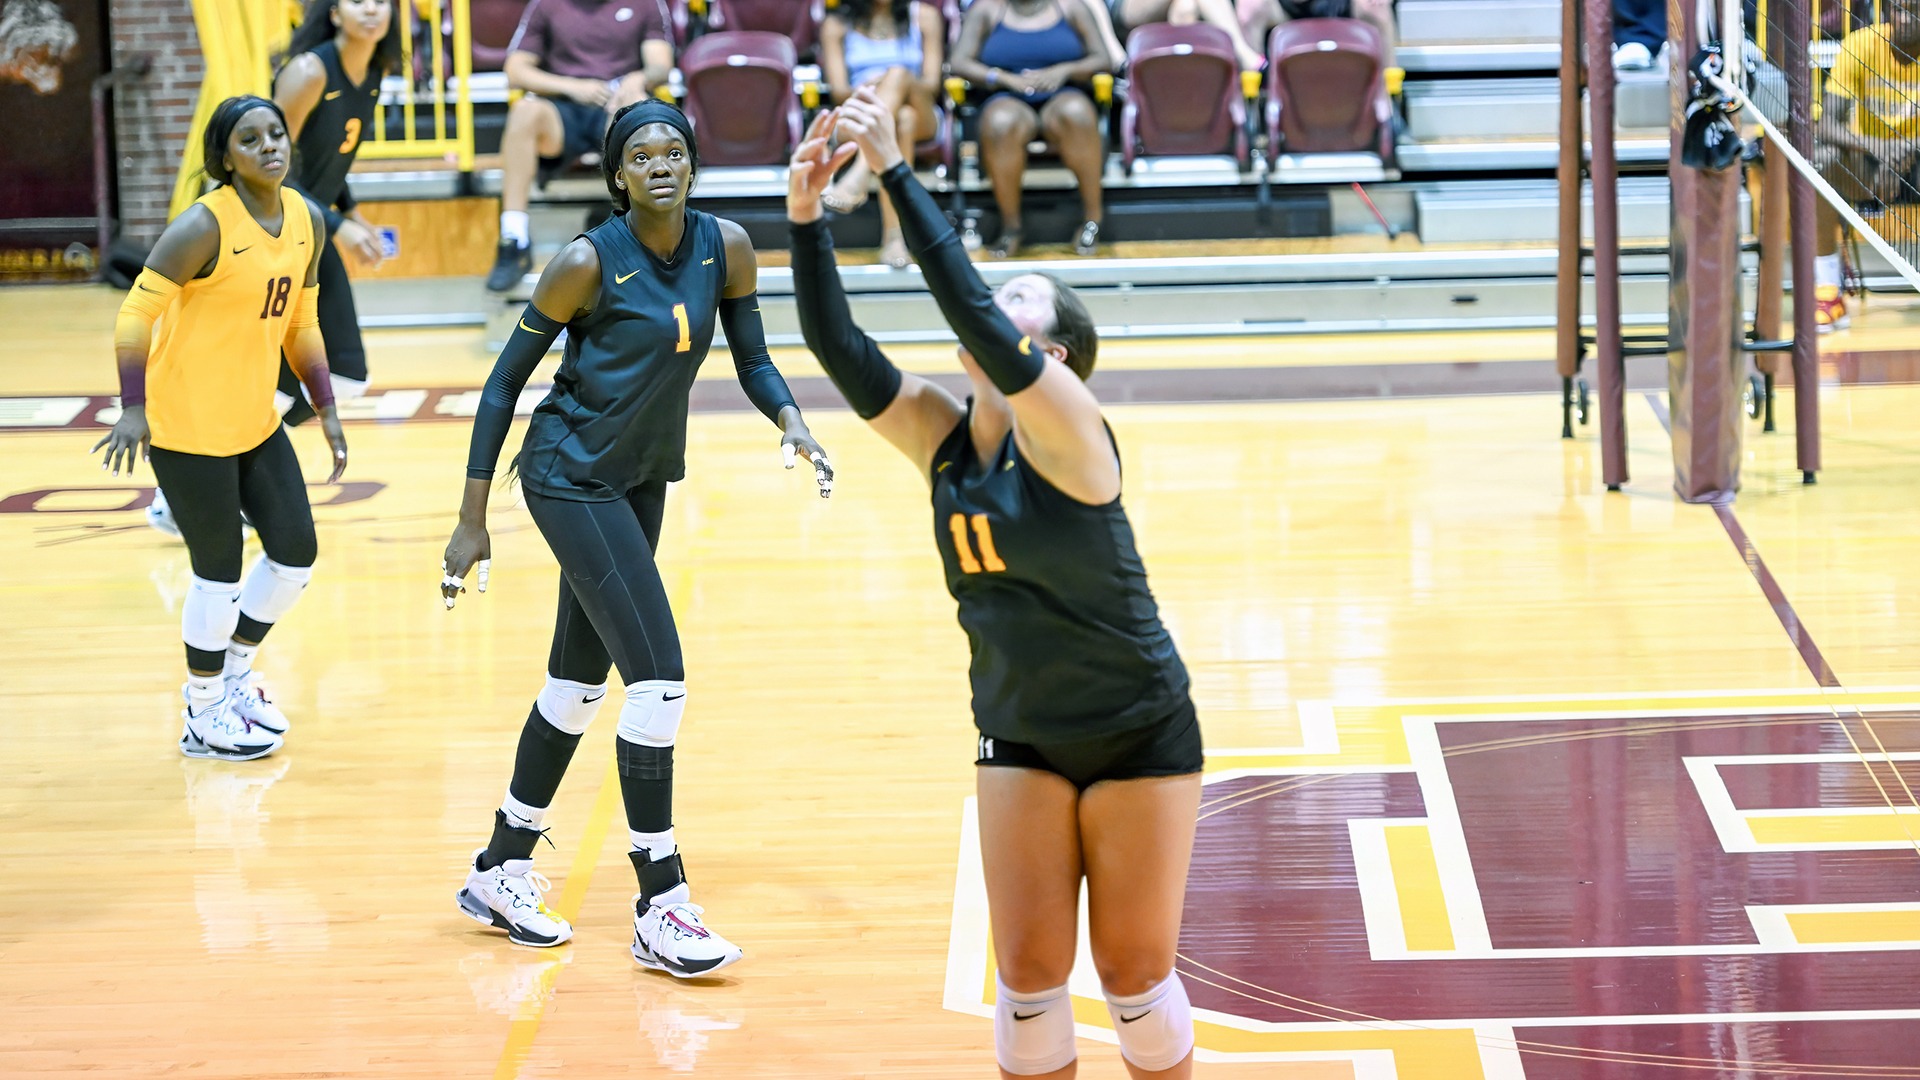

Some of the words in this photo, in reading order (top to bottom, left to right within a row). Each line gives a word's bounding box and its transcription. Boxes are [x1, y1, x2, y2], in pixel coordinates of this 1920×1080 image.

[338, 117, 362, 154] 3
[260, 276, 292, 319] 18
[672, 302, 692, 353] 1
[949, 512, 1007, 574] 11
